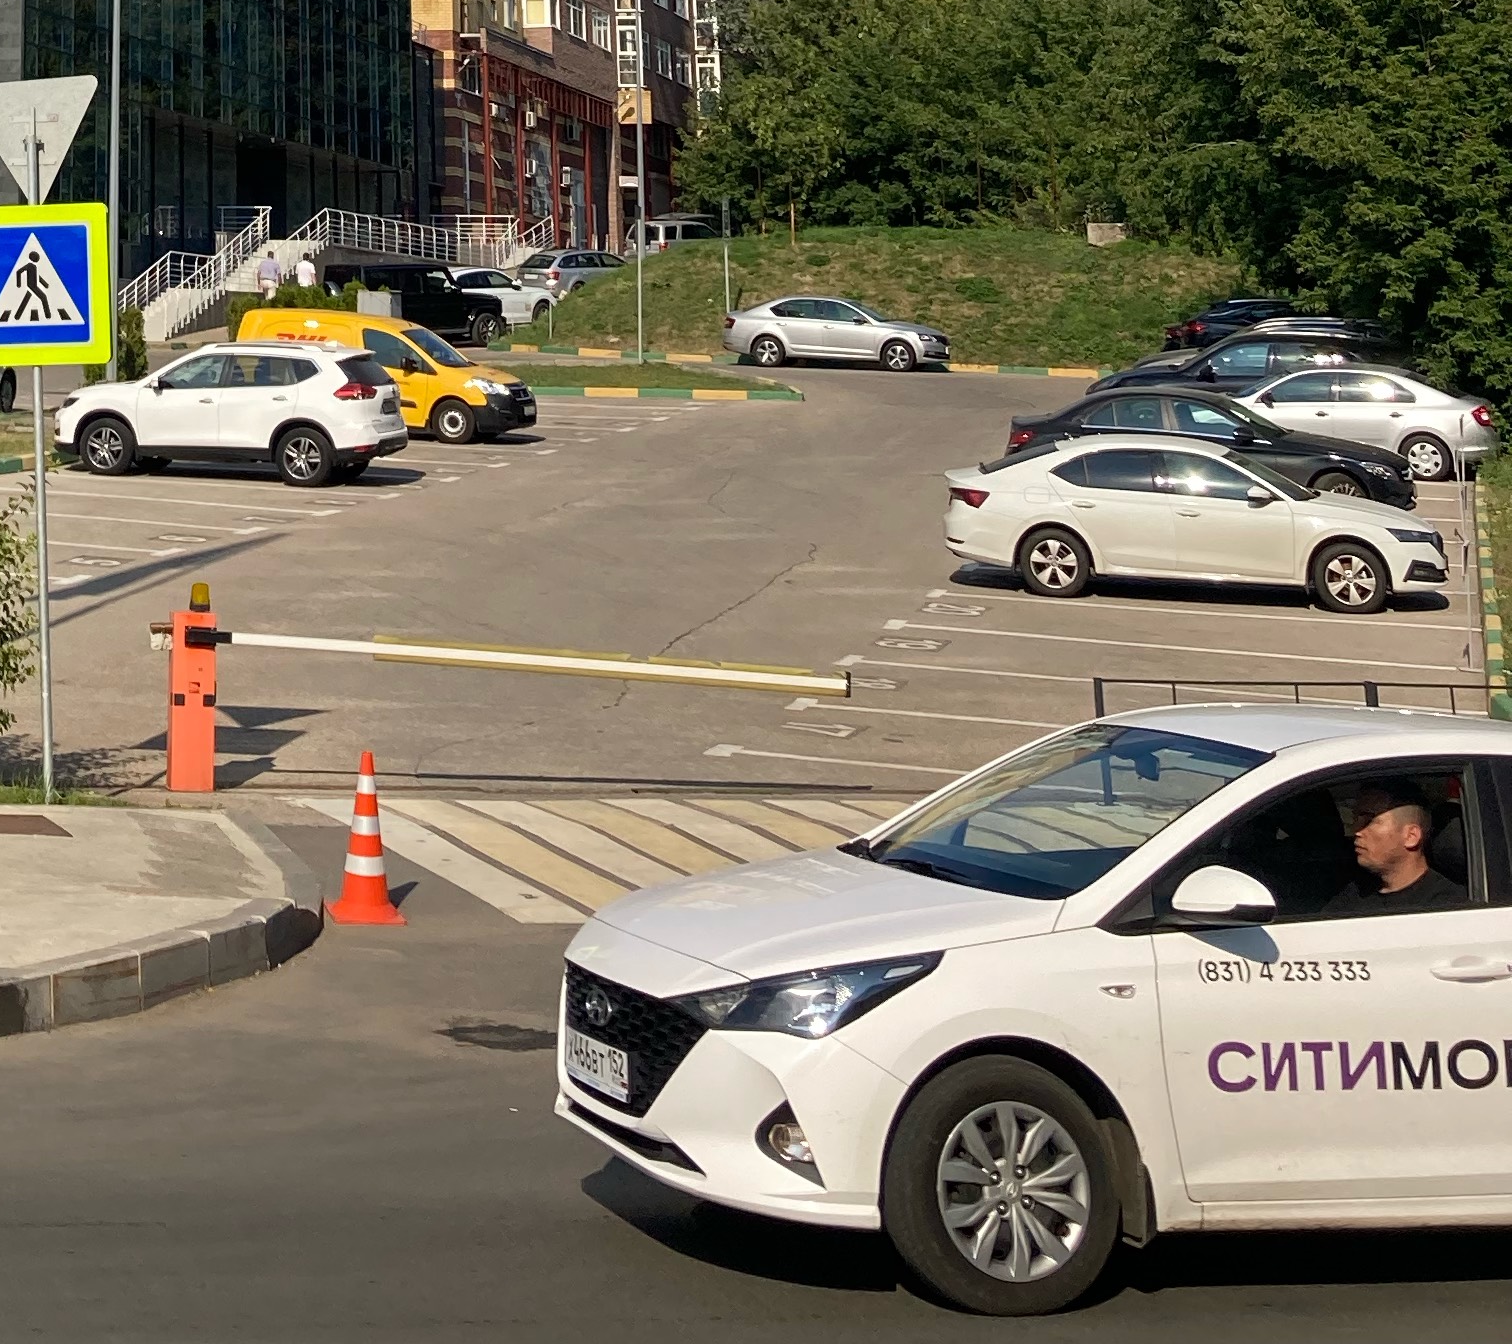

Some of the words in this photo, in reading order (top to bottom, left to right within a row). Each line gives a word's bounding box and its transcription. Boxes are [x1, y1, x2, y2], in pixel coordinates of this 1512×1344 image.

[1197, 958, 1251, 984] (831)
[1260, 961, 1274, 982] 4
[1280, 961, 1322, 982] 233
[1330, 961, 1372, 982] 333
[1207, 1039, 1512, 1093] СИТИМО
